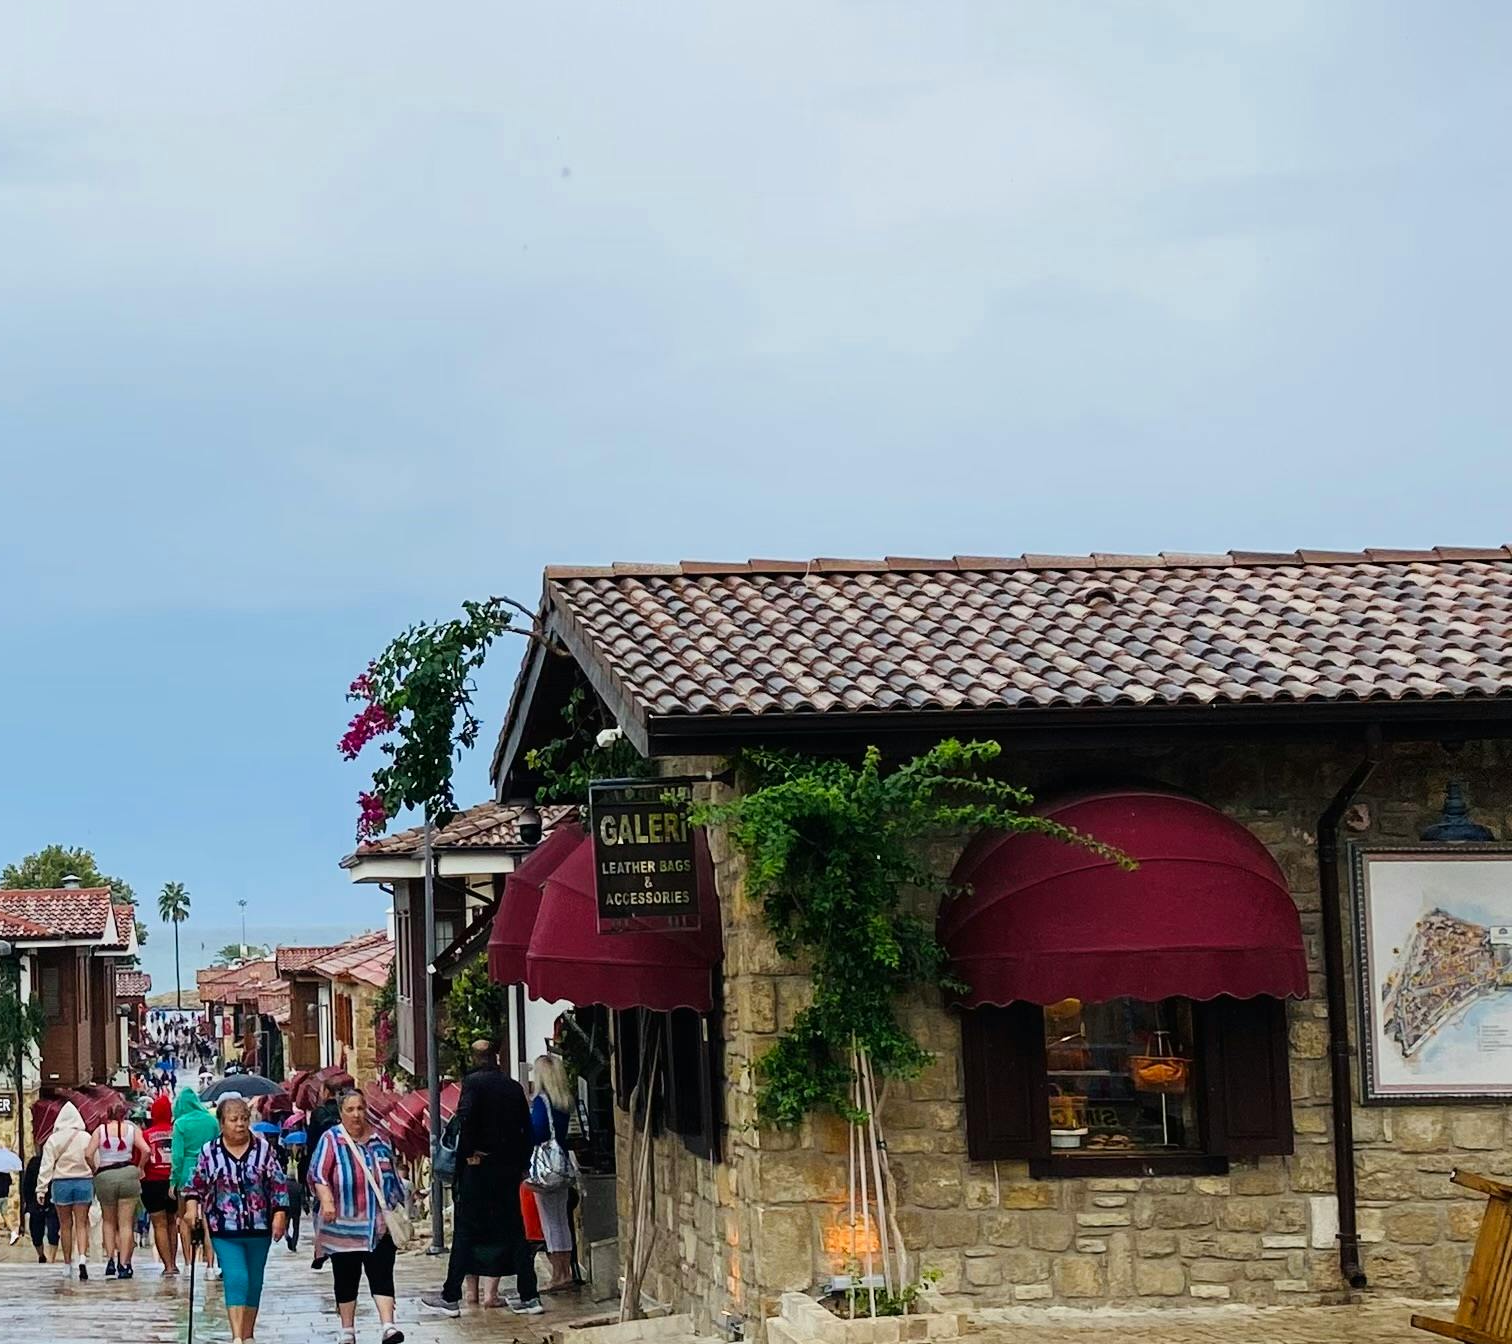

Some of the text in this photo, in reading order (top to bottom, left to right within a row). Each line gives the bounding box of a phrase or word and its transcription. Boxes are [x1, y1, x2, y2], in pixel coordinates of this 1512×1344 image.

[602, 859, 691, 874] LEATHER BAGS
[644, 876, 653, 888] &
[606, 891, 690, 905] ACCESSORIES
